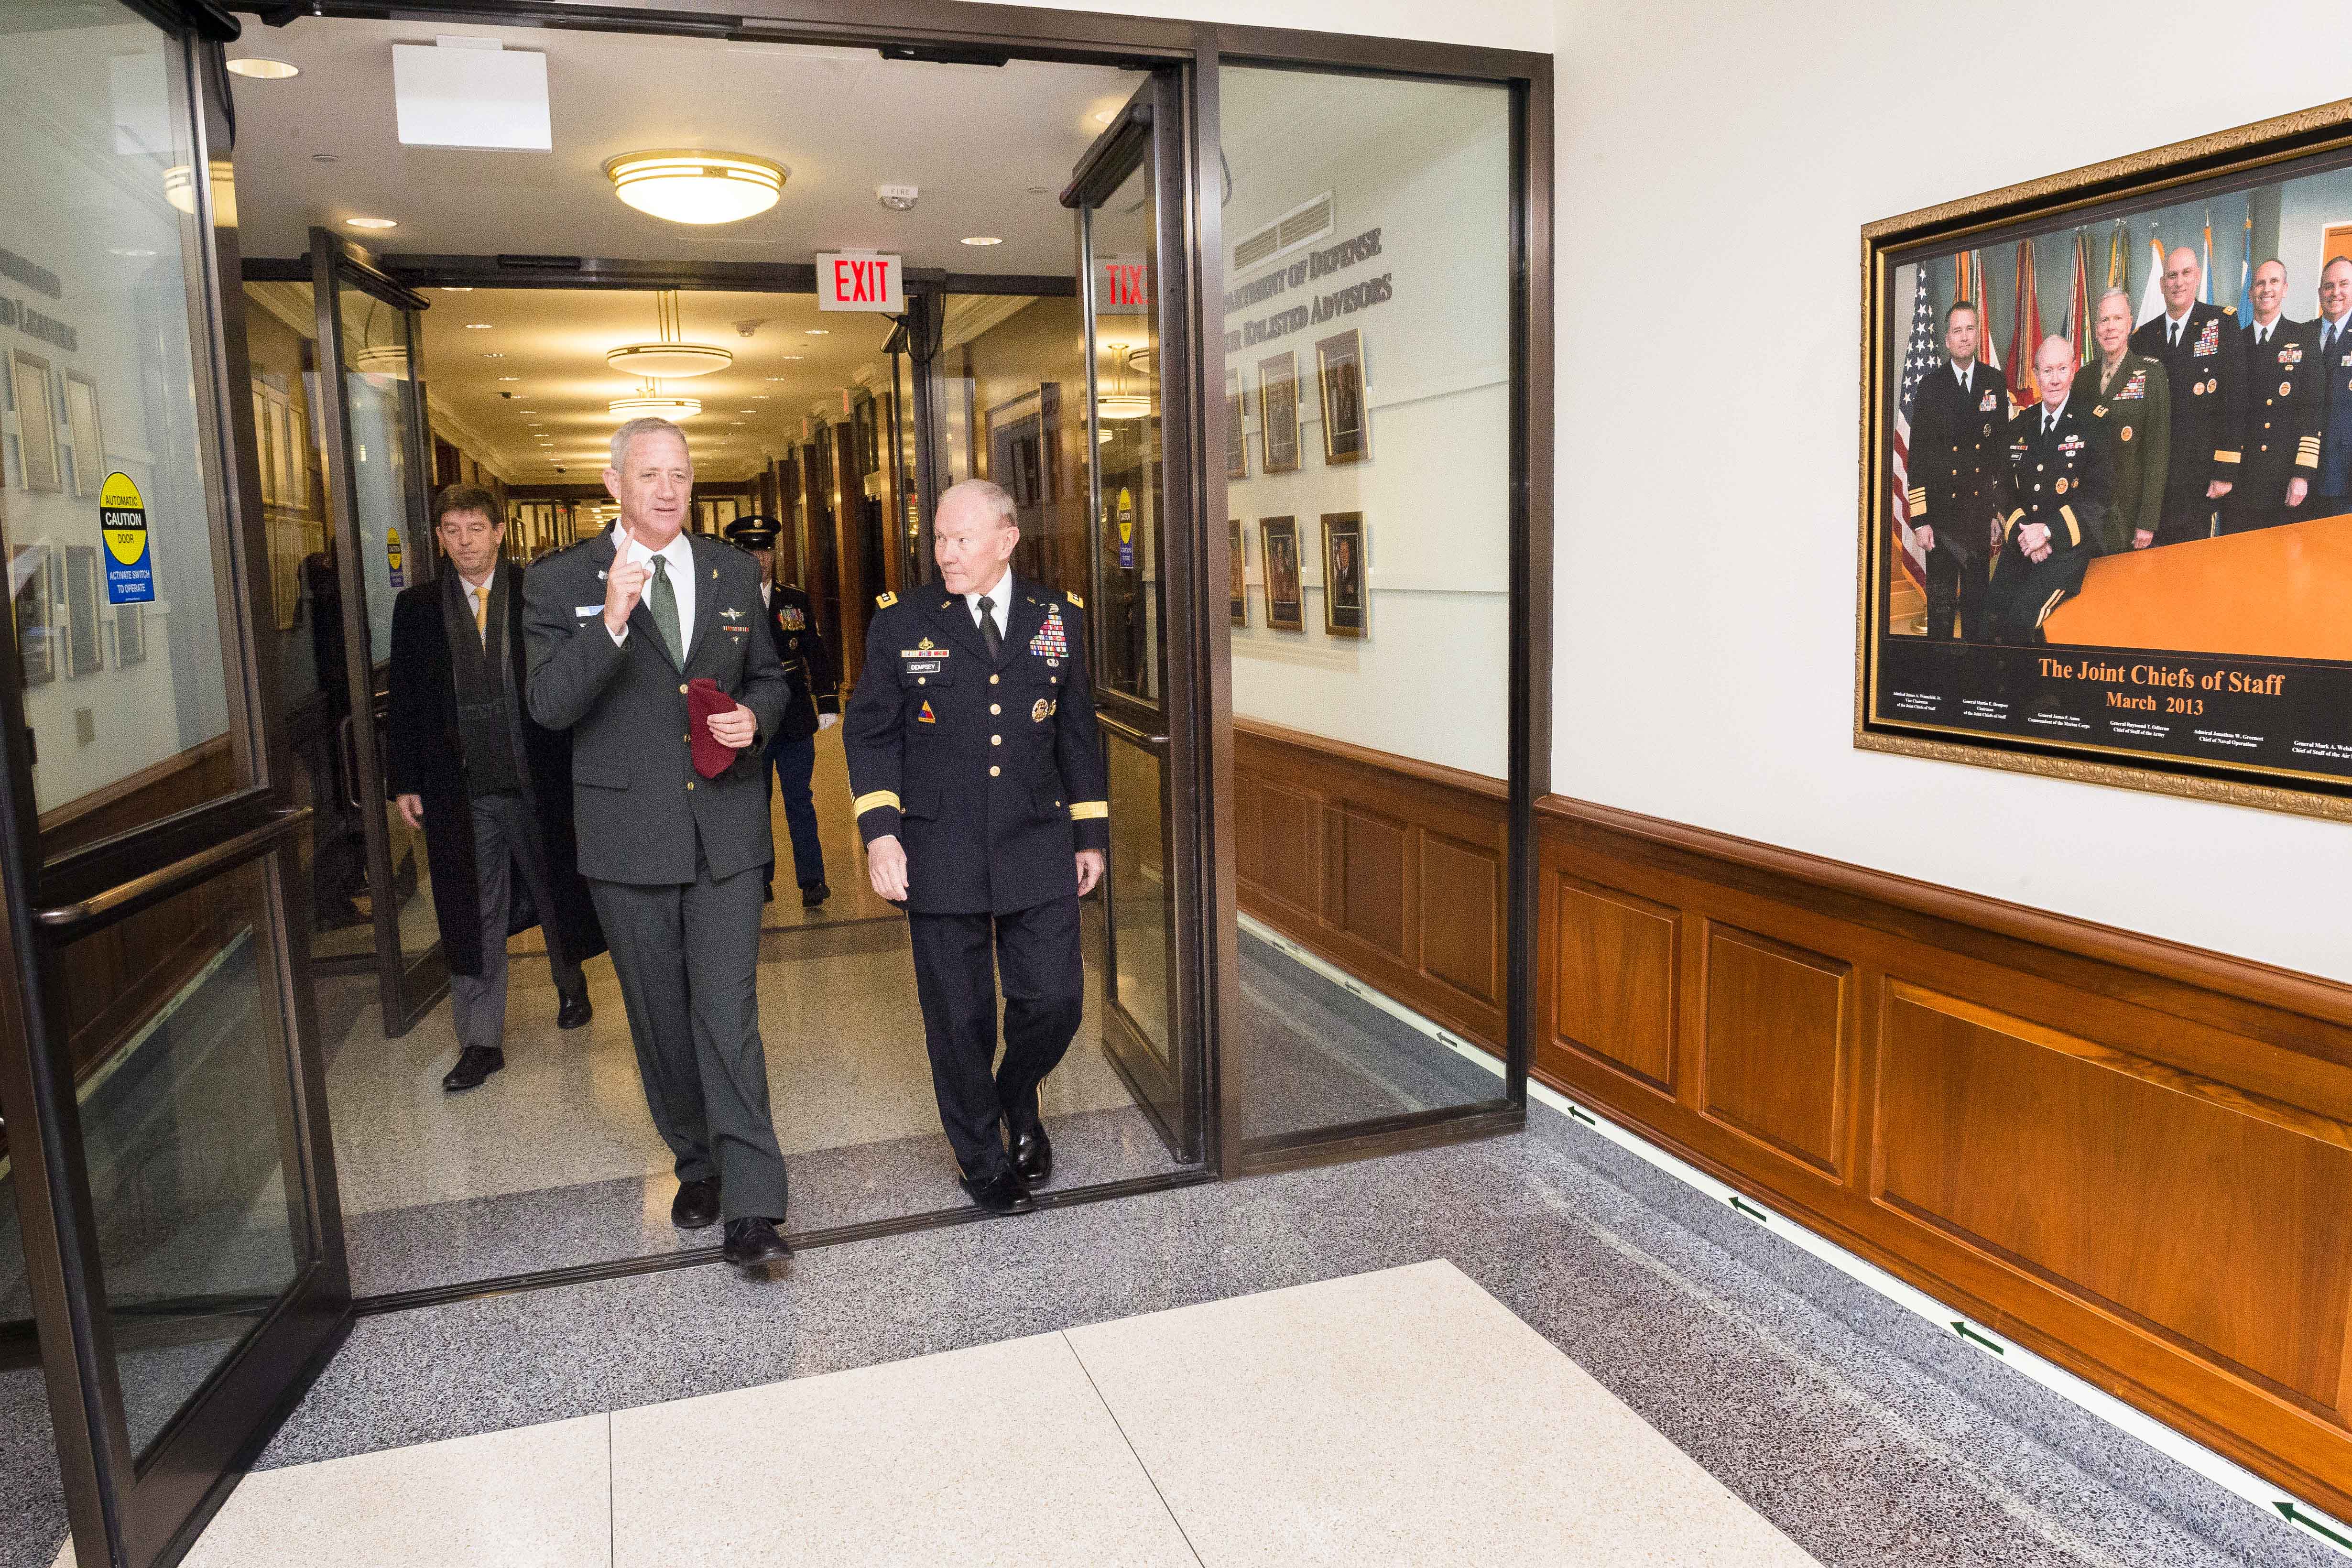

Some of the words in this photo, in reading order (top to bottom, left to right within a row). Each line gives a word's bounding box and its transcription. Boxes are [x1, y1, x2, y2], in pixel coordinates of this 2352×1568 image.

[835, 260, 888, 302] EXIT
[106, 495, 137, 506] AUTOMATIC
[105, 512, 142, 526] CAUTION
[118, 534, 134, 544] DOOR
[110, 571, 131, 580] ACTIVATE
[131, 570, 150, 579] SWITCH
[117, 585, 124, 593] TO
[124, 583, 145, 593] OPERATE
[2039, 658, 2072, 679] The
[2078, 661, 2125, 683] Joint
[2131, 664, 2195, 688] Chiefs
[2201, 670, 2224, 691] of
[2228, 672, 2285, 696] Staff
[2106, 691, 2156, 711] March
[2167, 697, 2203, 715] 2013
